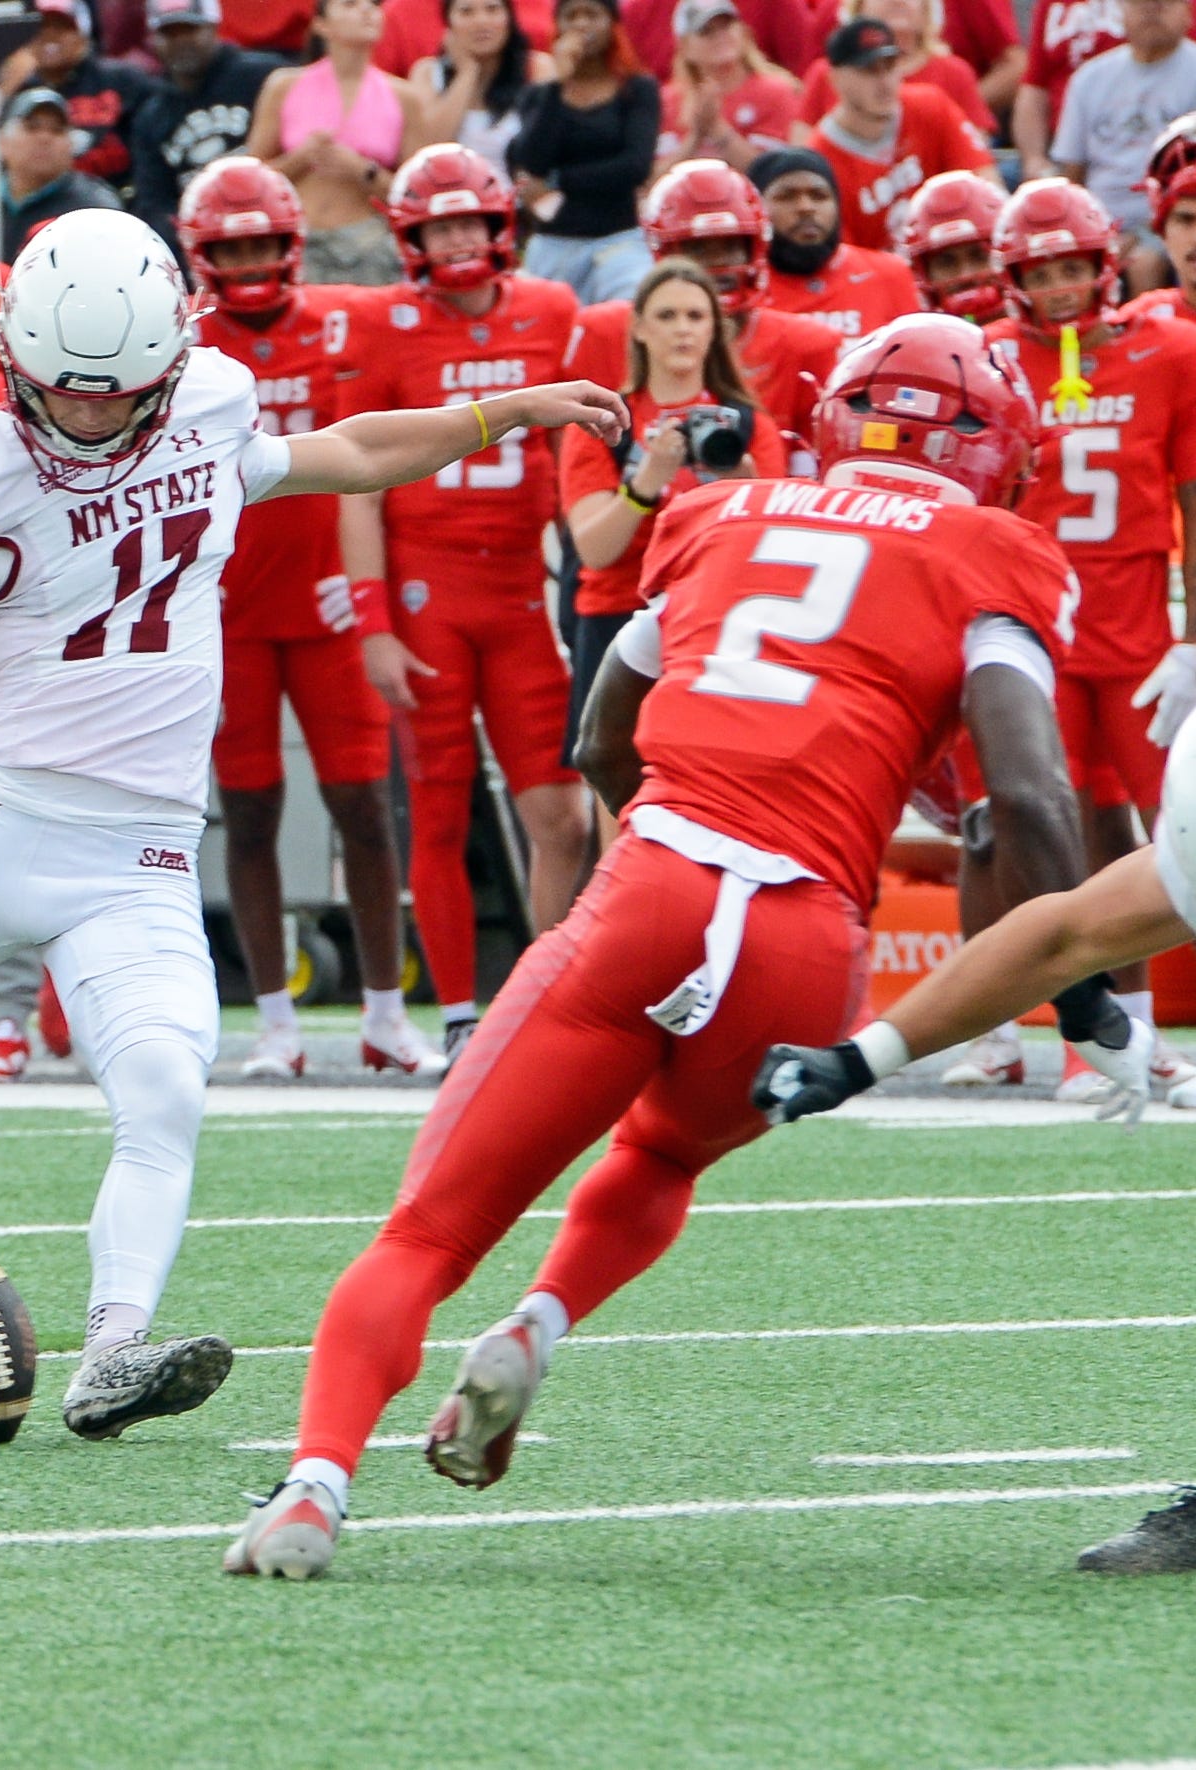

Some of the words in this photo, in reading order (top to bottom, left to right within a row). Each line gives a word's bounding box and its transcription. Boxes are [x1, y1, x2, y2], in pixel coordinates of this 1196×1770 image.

[441, 358, 526, 391] LOBOS
[67, 493, 119, 547] NM
[123, 461, 218, 525] STATE
[718, 484, 751, 520] A.
[761, 481, 944, 532] WILLIAMS
[1056, 427, 1121, 542] 5
[62, 507, 211, 661] 17
[687, 525, 874, 706] 2
[871, 931, 964, 973] ATO
